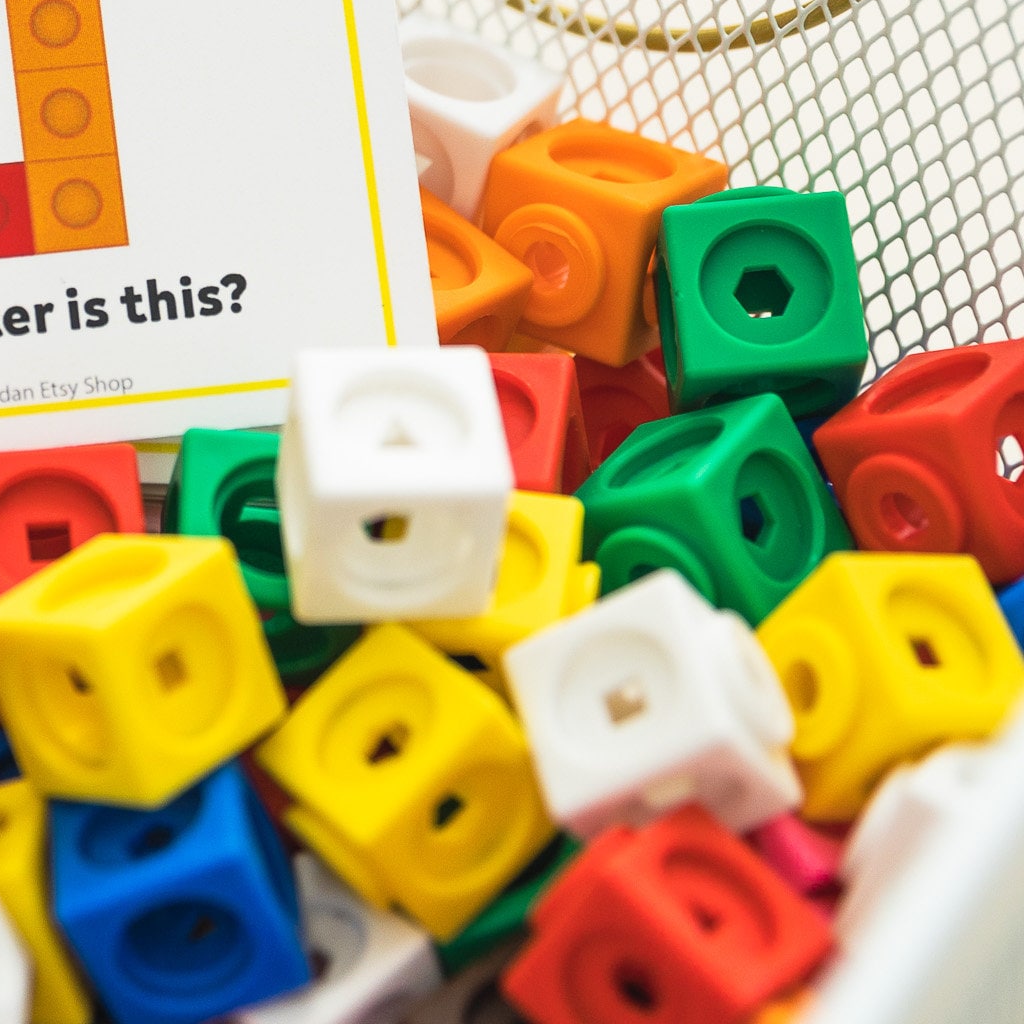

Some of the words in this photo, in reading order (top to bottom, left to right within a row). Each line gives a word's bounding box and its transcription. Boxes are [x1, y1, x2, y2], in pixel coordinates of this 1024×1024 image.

[66, 287, 109, 330] is
[120, 273, 247, 324] this?
[40, 379, 78, 401] Etsy
[84, 375, 134, 395] Shop
